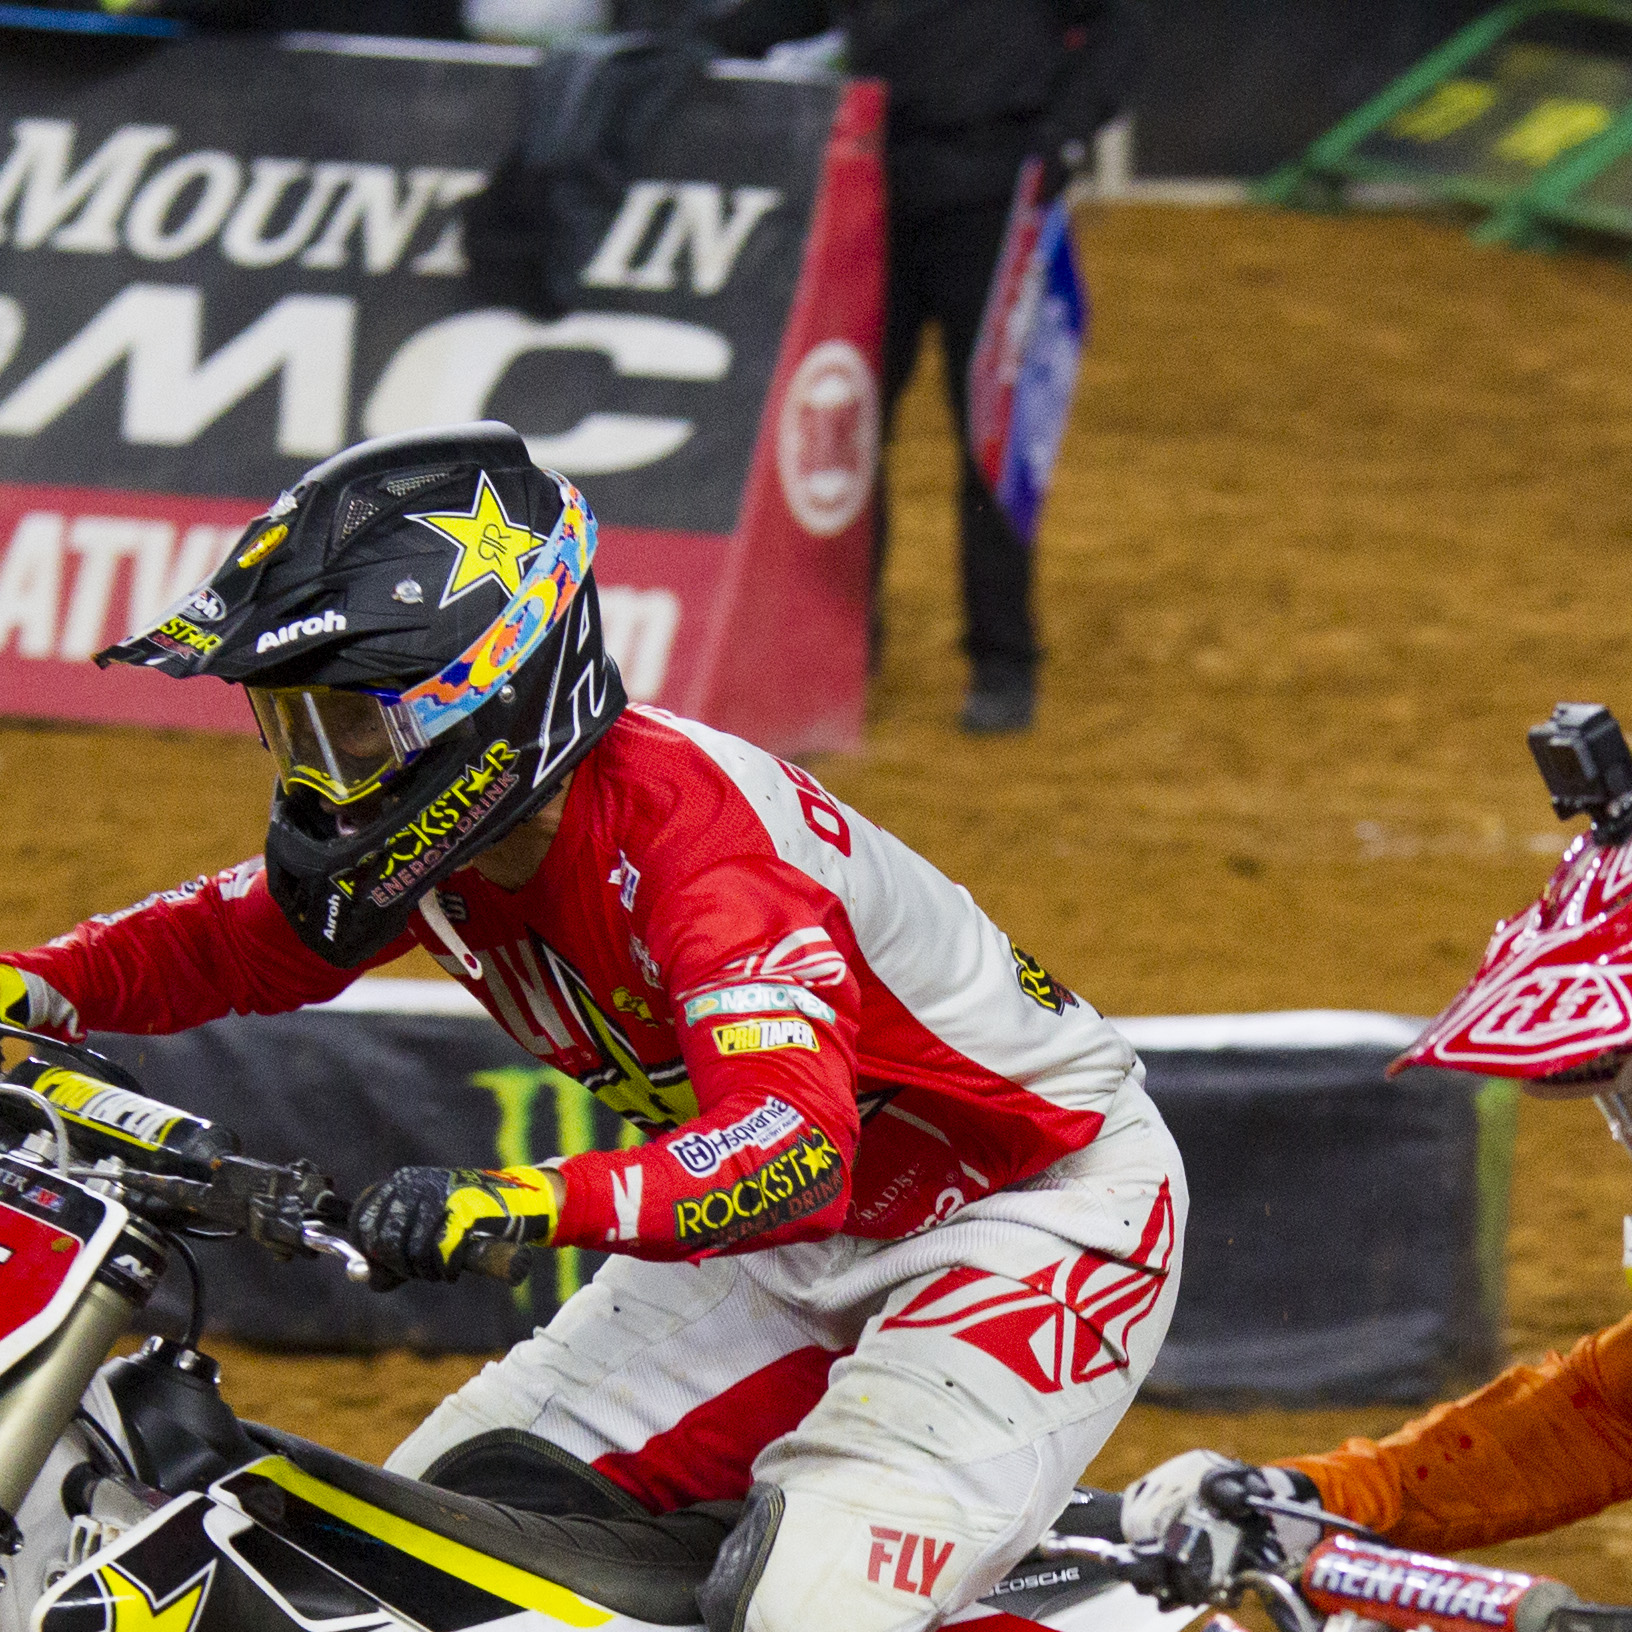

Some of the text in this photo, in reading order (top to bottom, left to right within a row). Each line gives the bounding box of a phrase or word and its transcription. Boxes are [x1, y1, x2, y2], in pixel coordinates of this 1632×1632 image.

[255, 612, 347, 656] Airoh
[370, 836, 451, 908] ENERGY
[448, 772, 516, 840] DRINK
[322, 894, 349, 943] Airoh
[718, 1018, 814, 1054] PROTAPER
[676, 1130, 838, 1240] ROCKSTAR
[868, 1525, 955, 1597] FLY
[1310, 1550, 1509, 1626] RENTHAL
